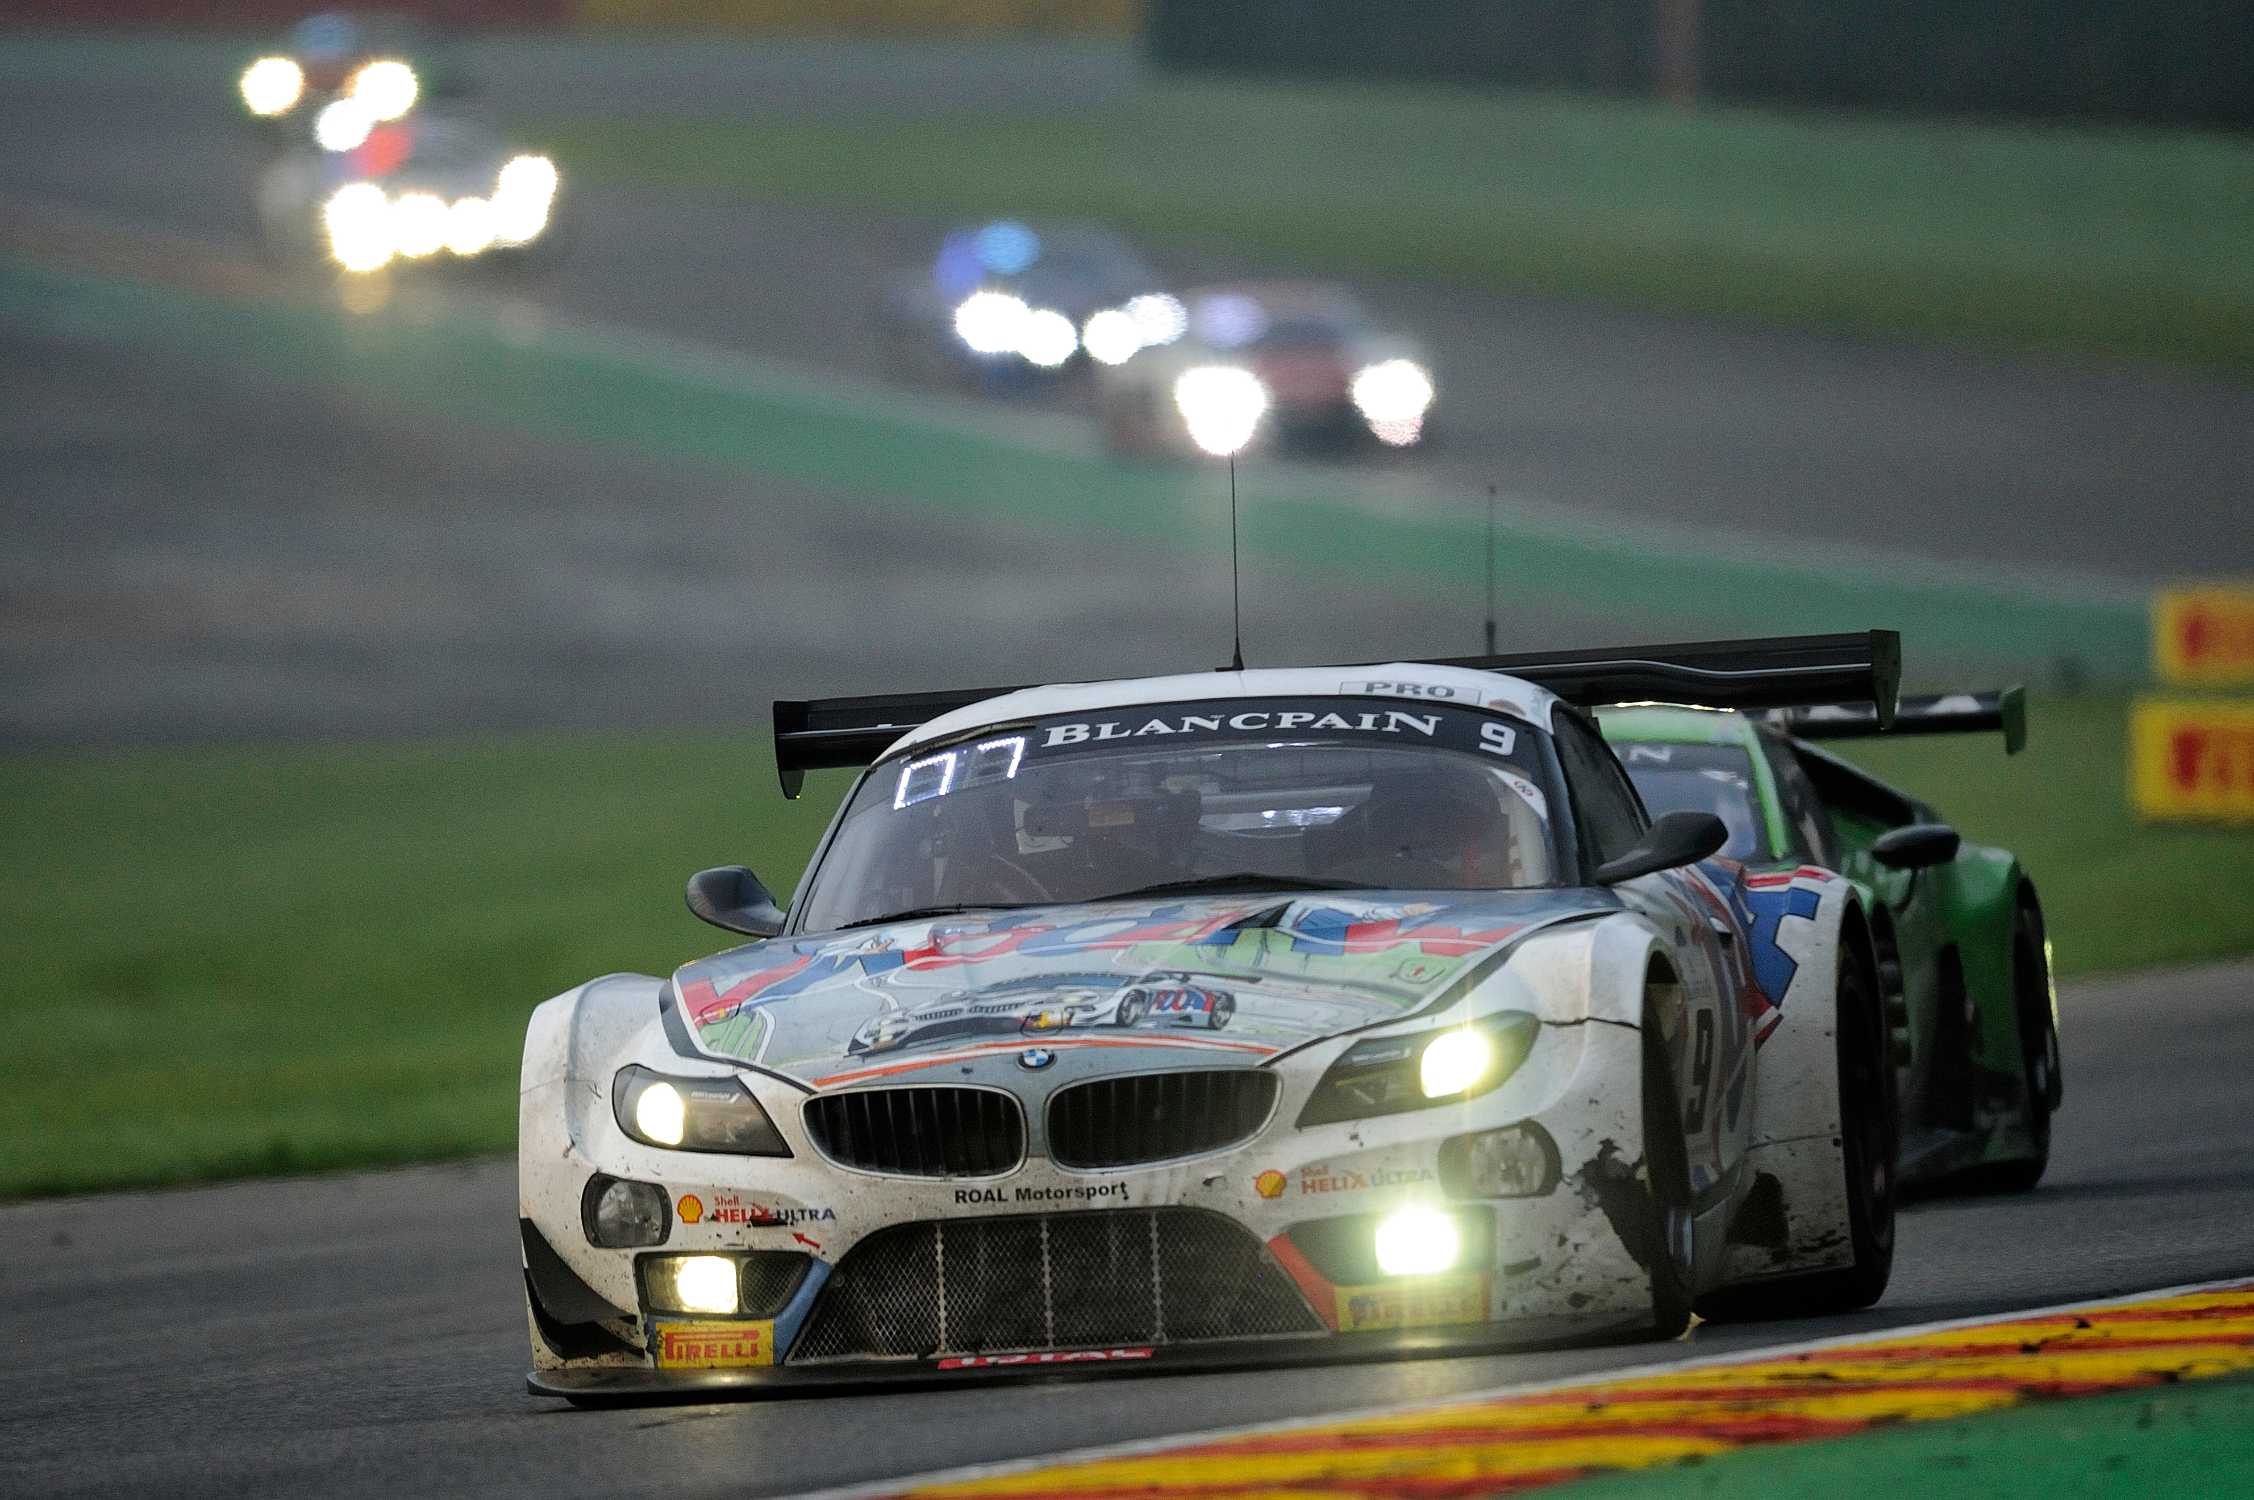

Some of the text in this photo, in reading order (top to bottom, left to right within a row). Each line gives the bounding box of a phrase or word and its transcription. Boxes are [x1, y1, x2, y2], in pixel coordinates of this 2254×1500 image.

[1365, 682, 1455, 698] PRO
[1041, 711, 1443, 748] BLANCPAIN
[1479, 722, 1516, 756] 9
[954, 1181, 1129, 1204] ROAL Motorsport
[1301, 1172, 1369, 1194] HELIX
[714, 1194, 739, 1206] Shell
[775, 1207, 837, 1222] ULTRA
[664, 1329, 759, 1360] PIRELLI
